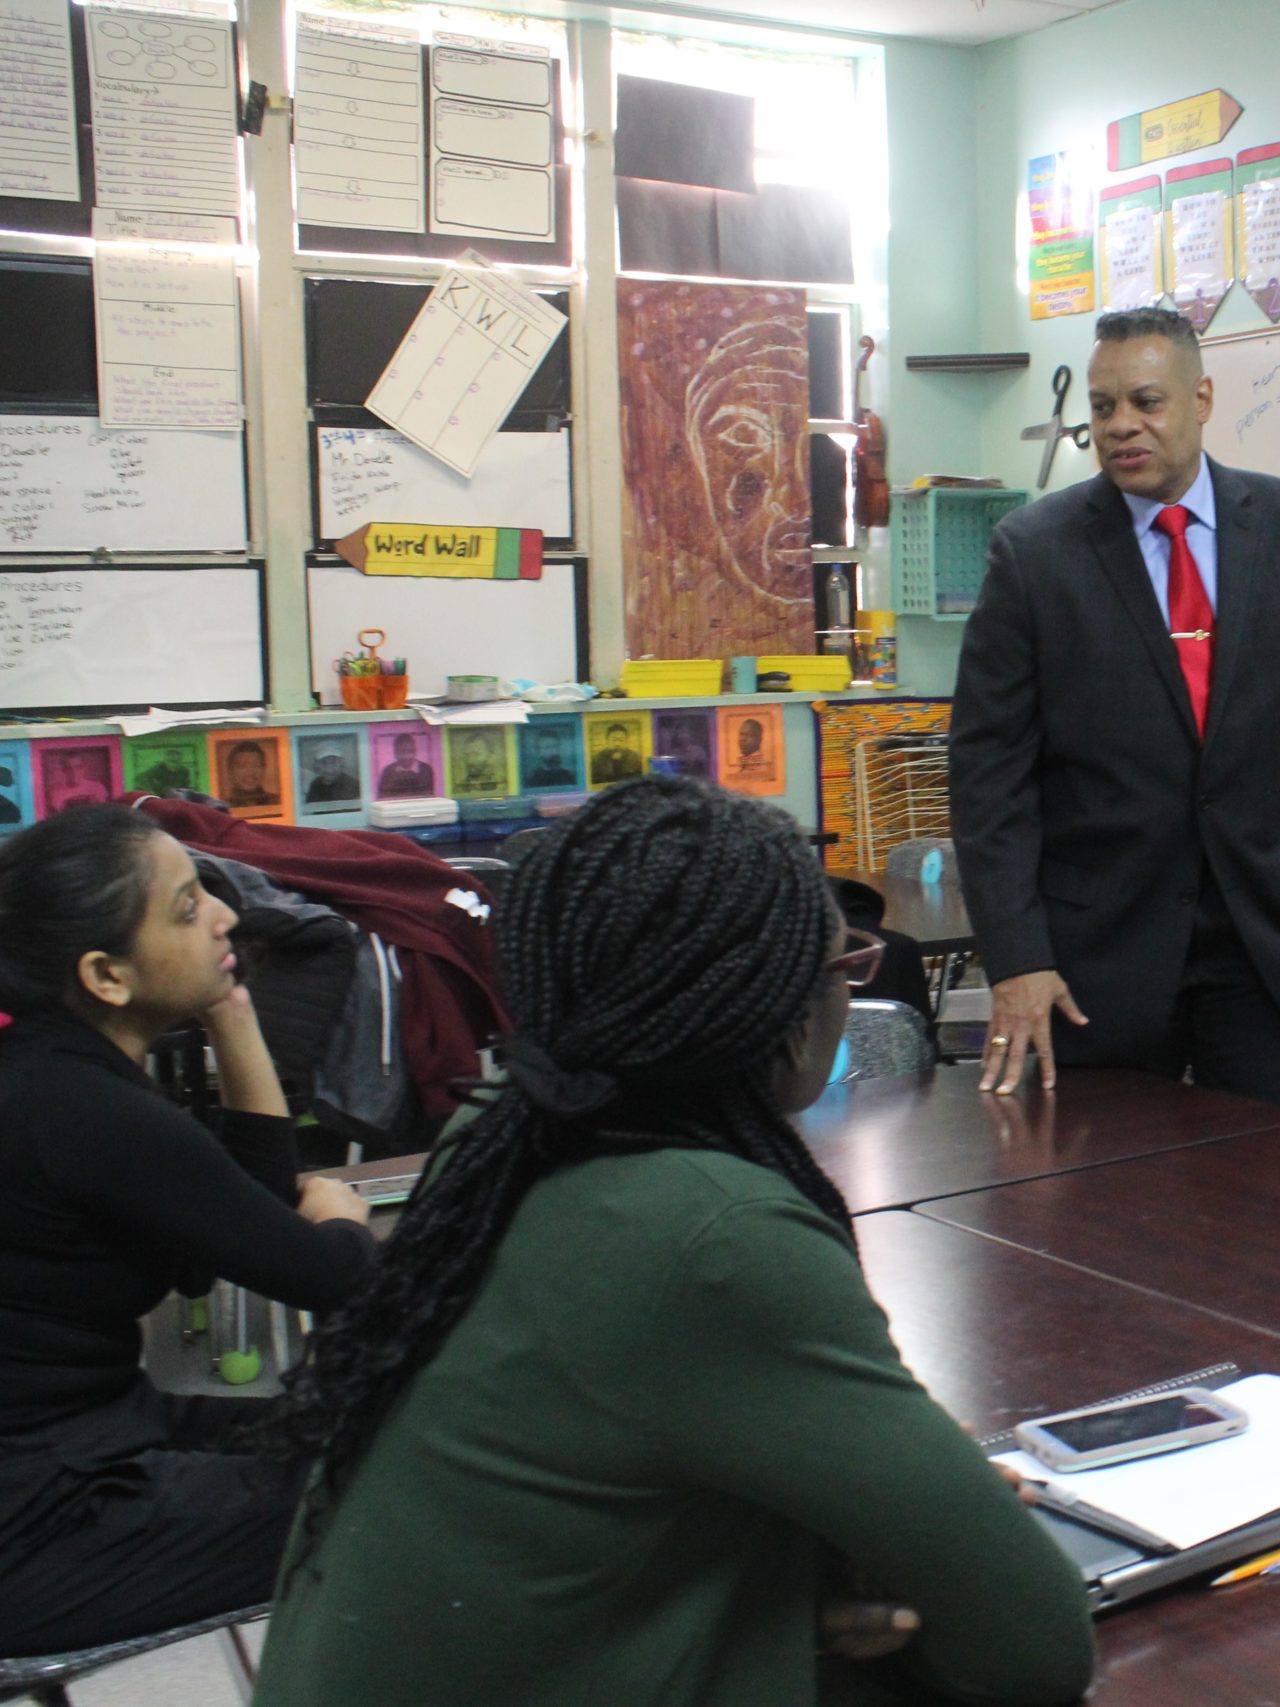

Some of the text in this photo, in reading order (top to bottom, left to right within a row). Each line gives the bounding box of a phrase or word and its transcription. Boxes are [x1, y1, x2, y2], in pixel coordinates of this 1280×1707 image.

[440, 277, 469, 310] K
[477, 298, 508, 331] W
[511, 325, 530, 358] L
[1194, 288, 1206, 323] 1
[0, 420, 82, 436] rocedures
[374, 534, 481, 558] Word Wall
